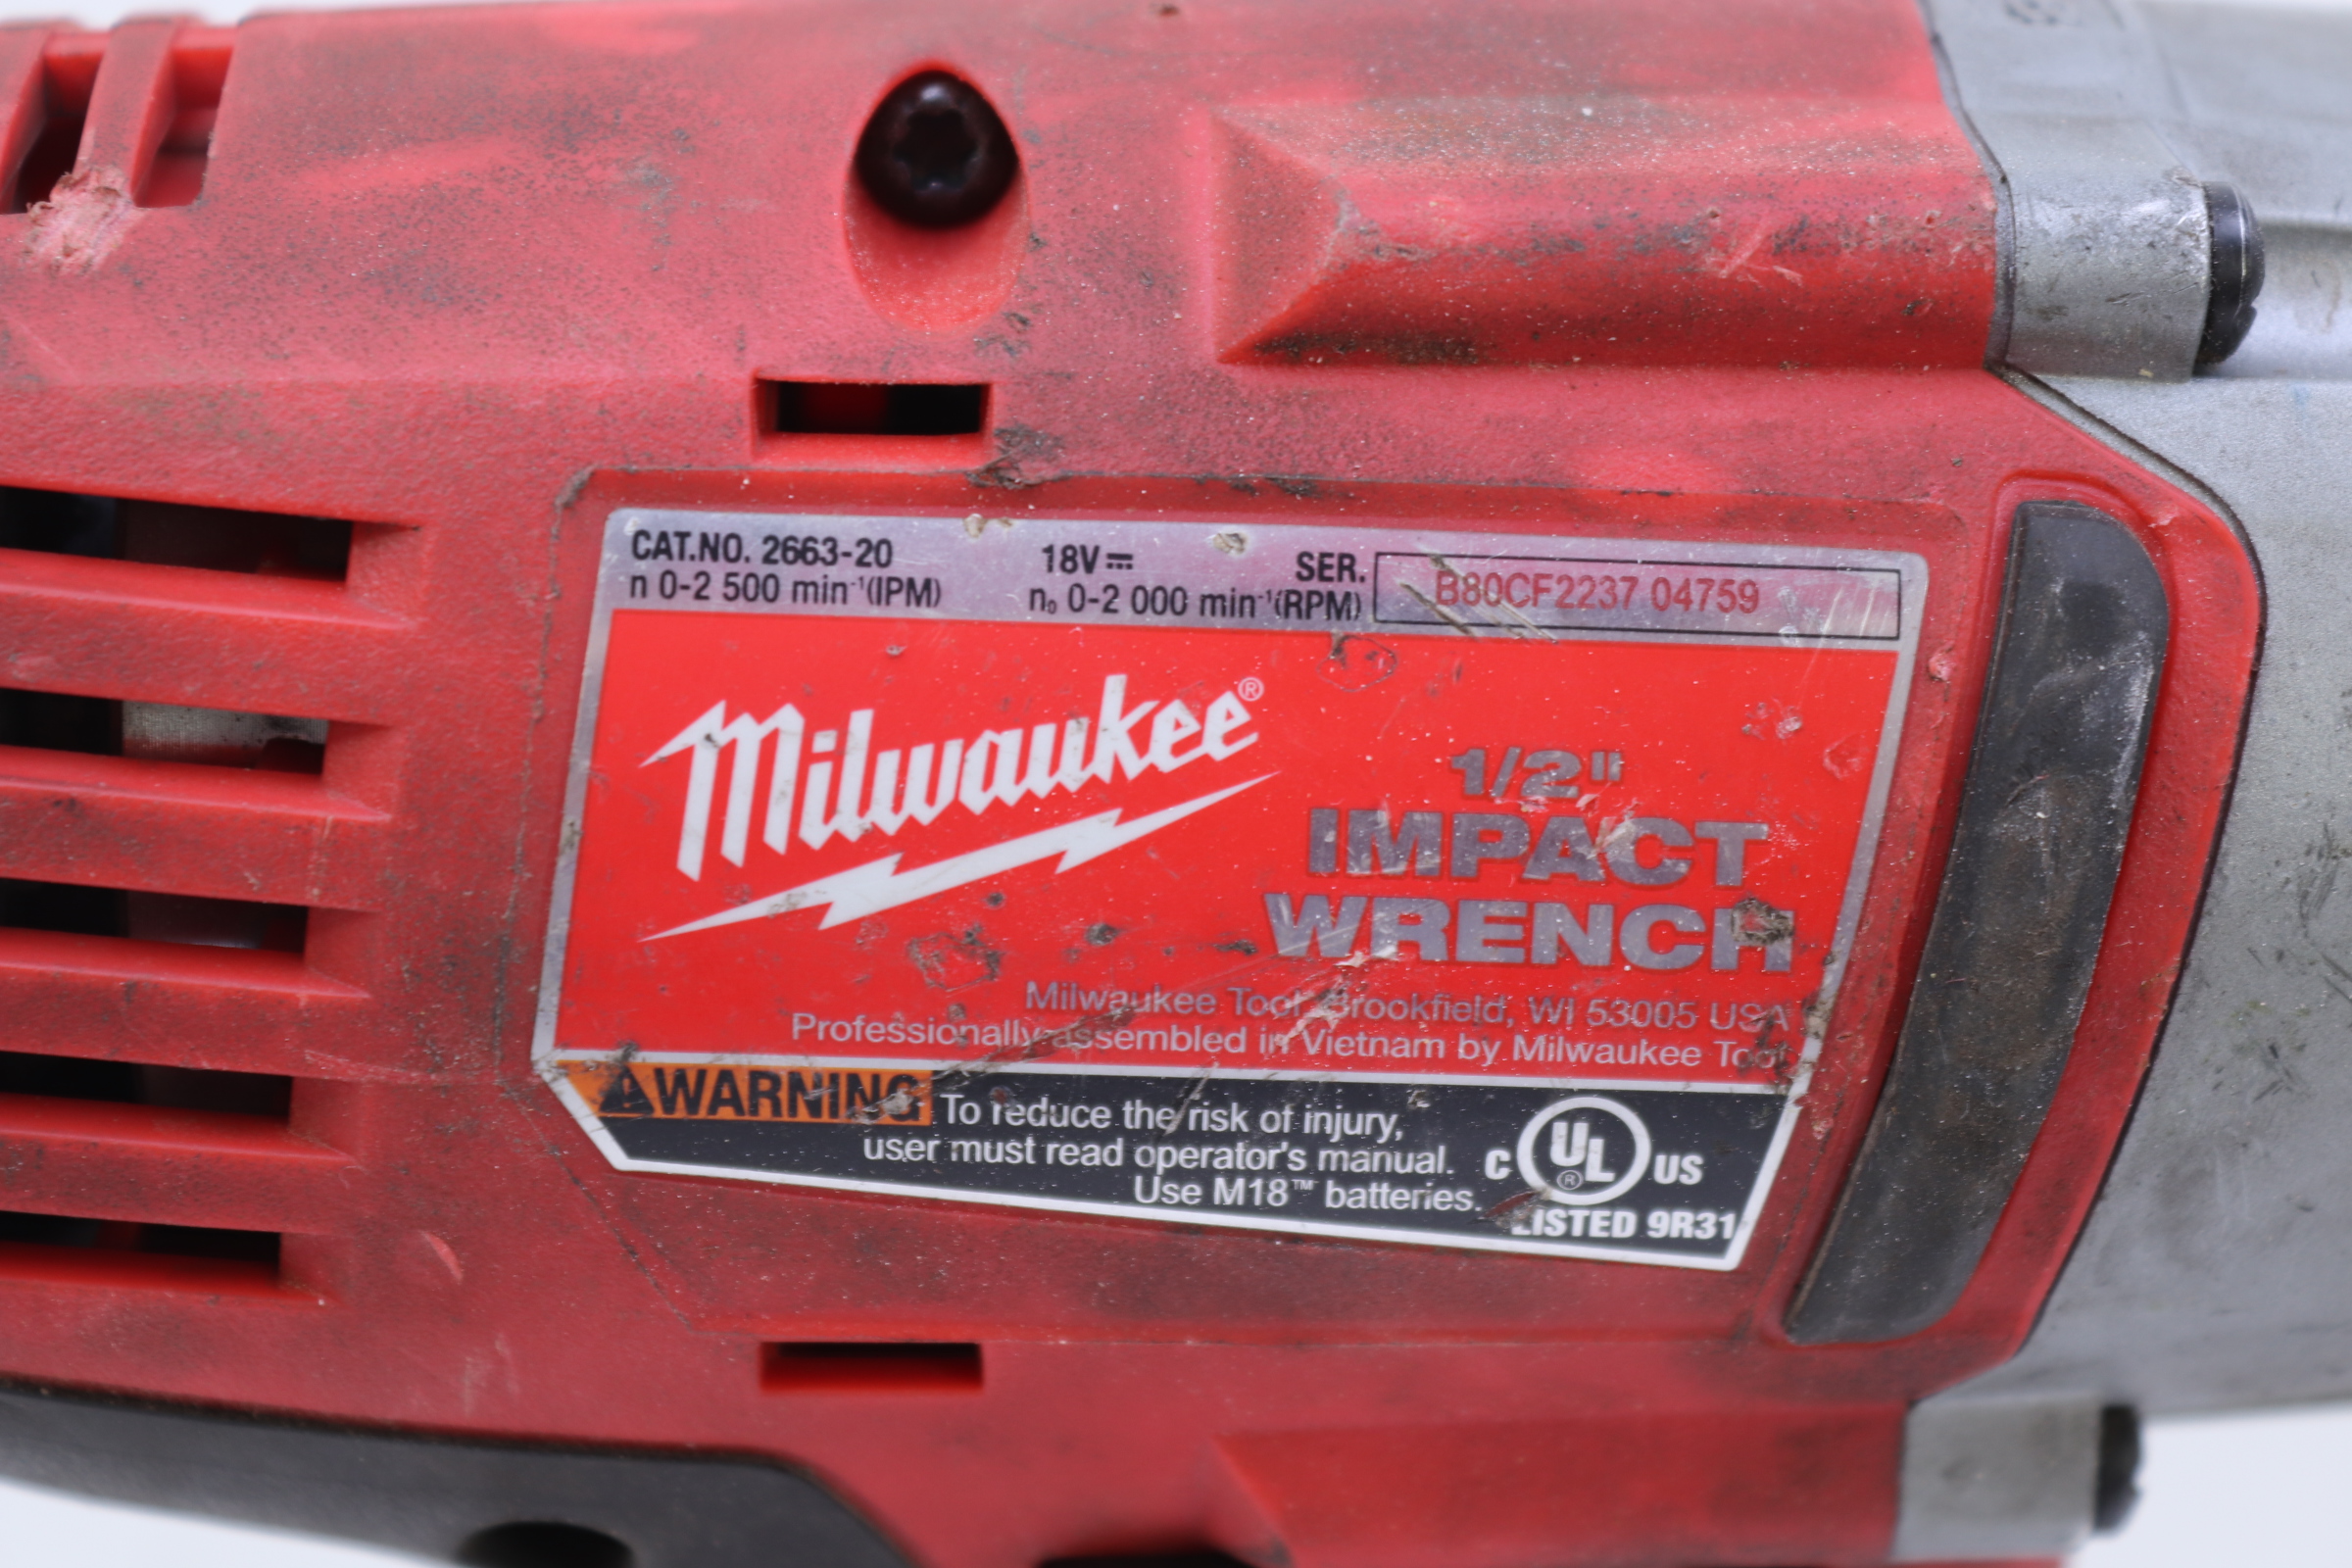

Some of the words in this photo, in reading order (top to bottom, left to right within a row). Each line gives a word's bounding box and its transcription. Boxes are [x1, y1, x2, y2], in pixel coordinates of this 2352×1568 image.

[631, 530, 751, 564] CAT.NO.
[762, 535, 893, 568] 2663-20
[630, 574, 647, 599] n
[659, 569, 710, 601] 0-2
[723, 572, 780, 603] 500
[1067, 583, 1119, 613] 0-2
[1131, 585, 1188, 616] 000
[1296, 552, 1366, 583] SER.
[1435, 570, 1637, 611] B80CF2237
[1649, 576, 1760, 614] 04759
[1450, 747, 1622, 800] 1/2"
[1307, 808, 1769, 887] IMPACT
[1263, 893, 1794, 973] WRENCH
[1025, 981, 1217, 1016] Milwaukee
[1529, 996, 1574, 1026] WI
[1587, 998, 1696, 1029] 53005
[1710, 1003, 1789, 1032] USA
[792, 1012, 1042, 1050] Professionally
[1052, 1024, 1247, 1054] assembled
[1259, 1026, 1289, 1054] in
[1302, 1028, 1446, 1059] Vietnam
[1457, 1033, 1499, 1067] by
[1512, 1034, 1702, 1066] Milwaukee
[654, 1067, 920, 1121] WARNING
[940, 1094, 981, 1125] To
[992, 1097, 1112, 1128] reduce
[1123, 1099, 1174, 1130] the
[1188, 1102, 1250, 1133] risk
[1259, 1103, 1293, 1134] of
[1302, 1104, 1404, 1144] injury,
[863, 1136, 941, 1163] user
[951, 1136, 1036, 1164] must
[1046, 1138, 1124, 1168] read
[1134, 1141, 1307, 1174] operator's
[1318, 1145, 1454, 1175] manual.
[1133, 1175, 1202, 1204] Use
[1325, 1180, 1482, 1212] batteries.
[1647, 1210, 1736, 1240] 9R31
